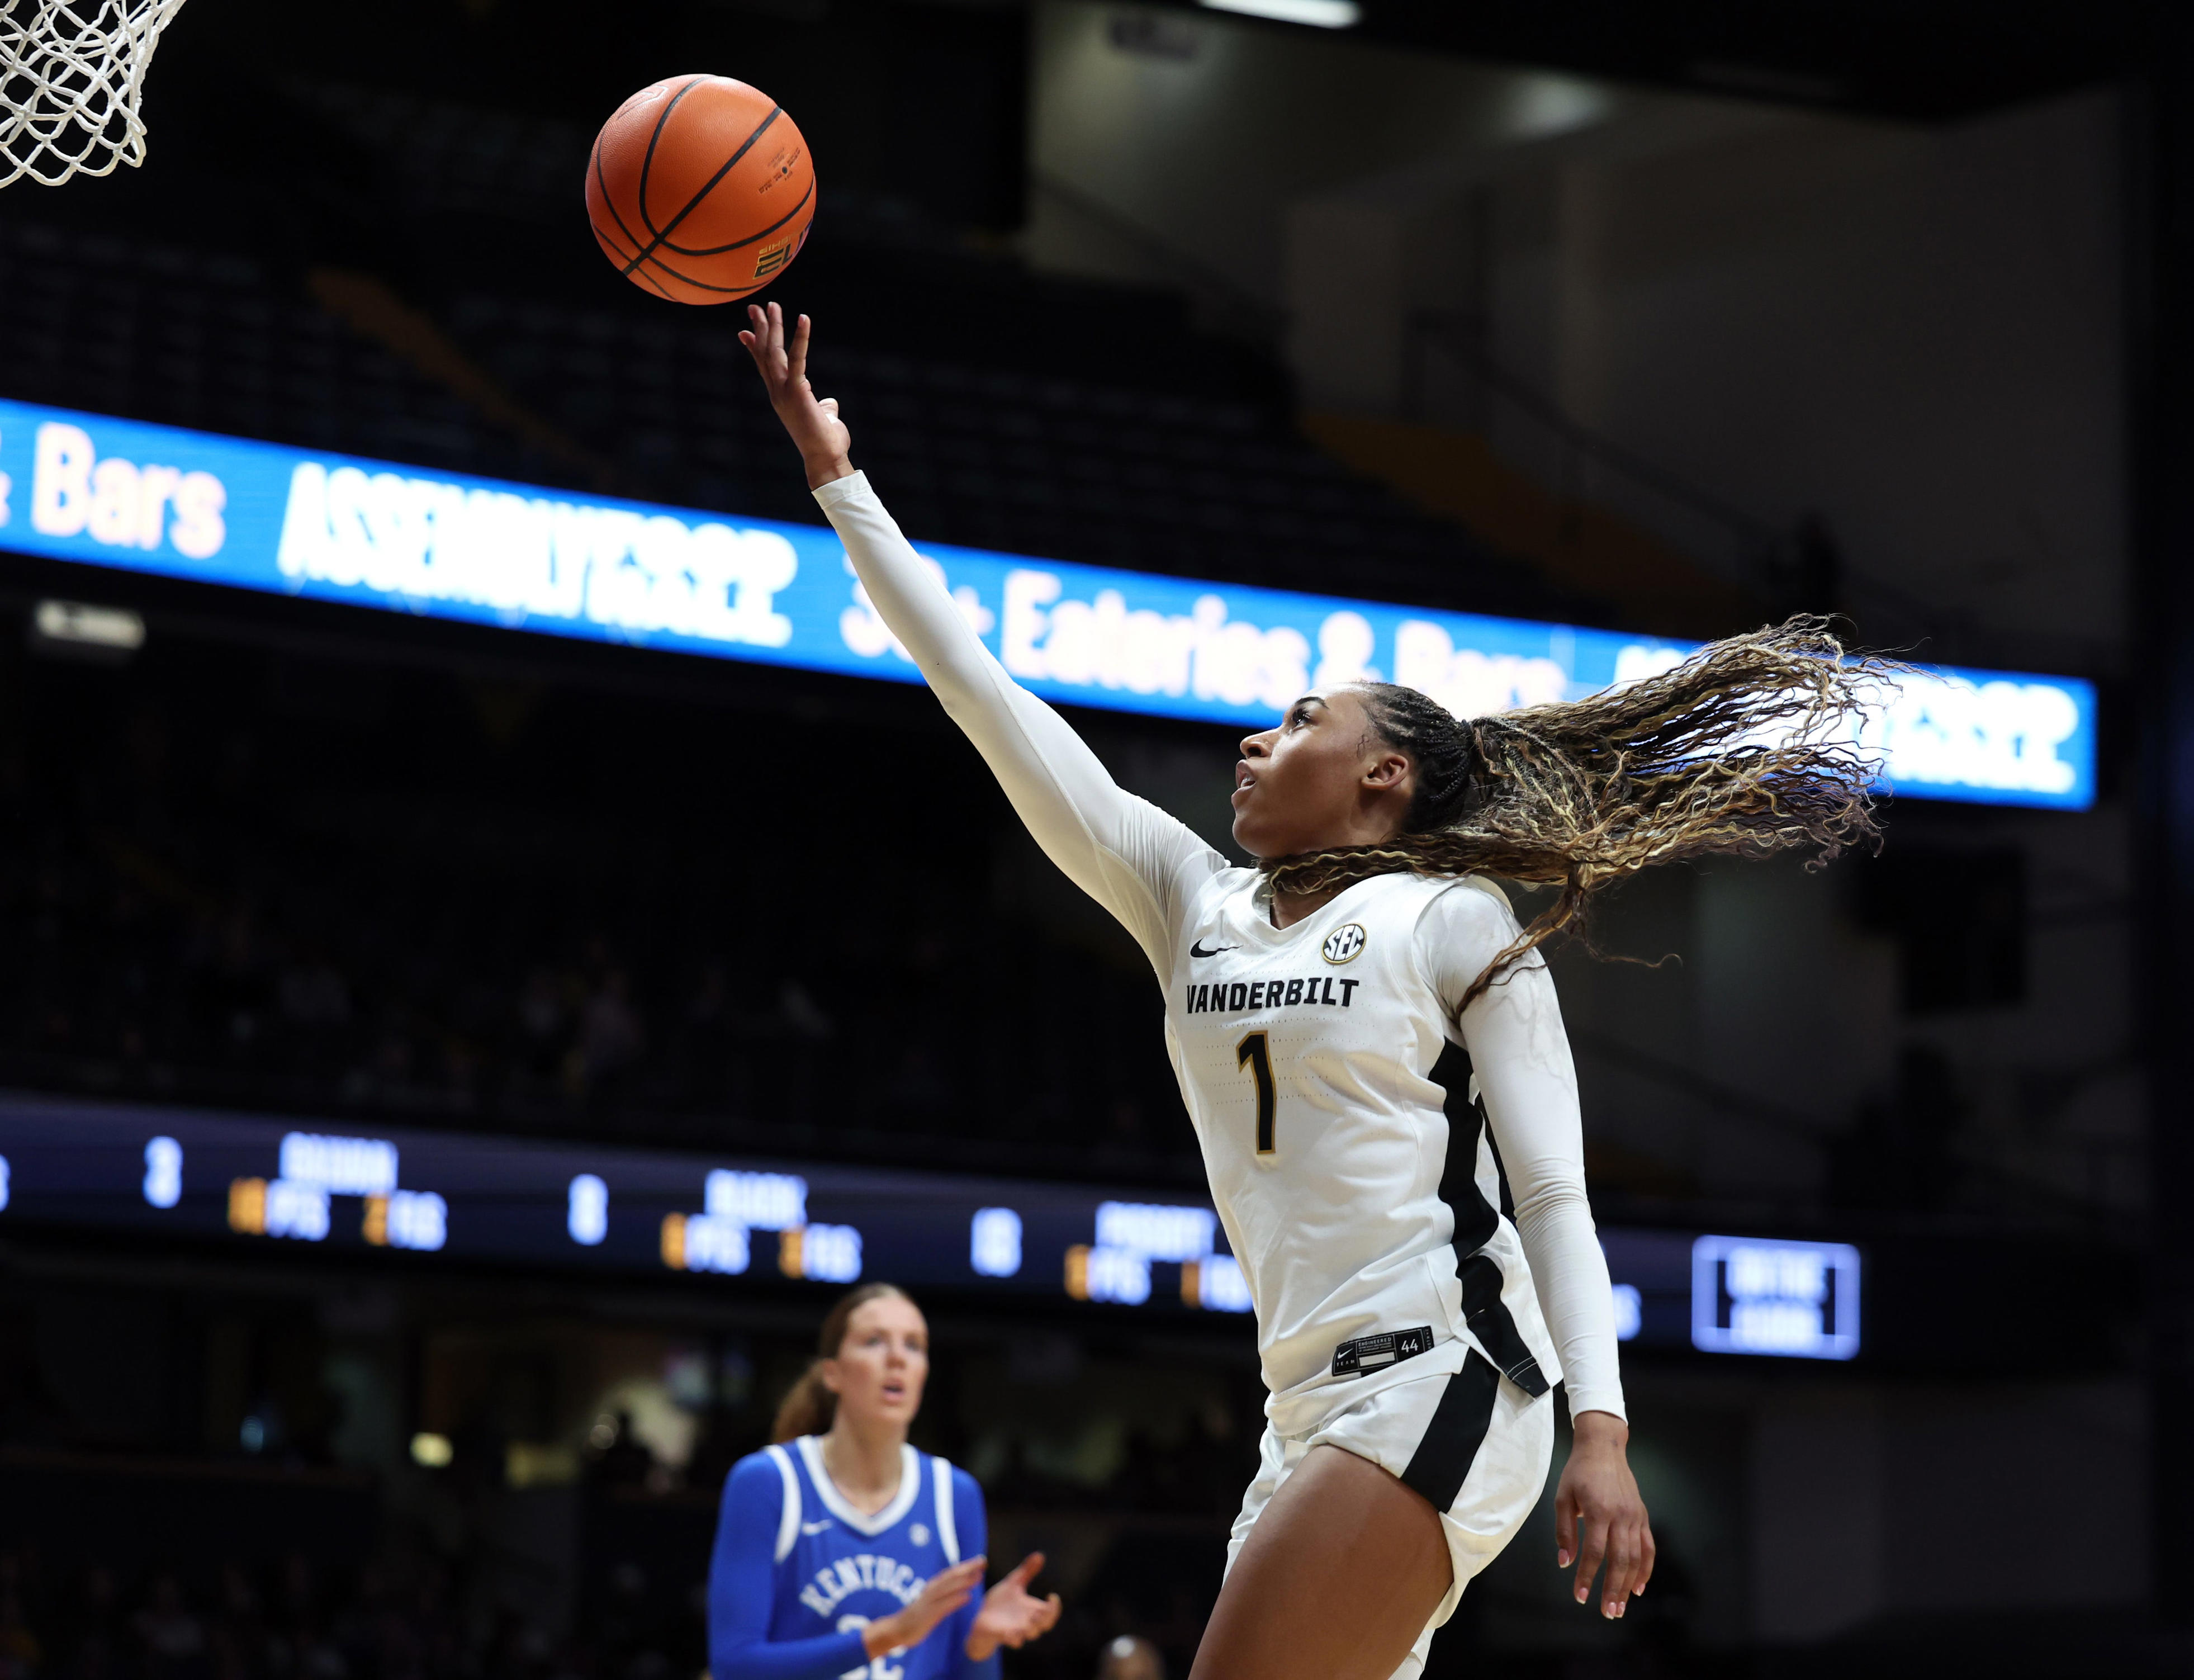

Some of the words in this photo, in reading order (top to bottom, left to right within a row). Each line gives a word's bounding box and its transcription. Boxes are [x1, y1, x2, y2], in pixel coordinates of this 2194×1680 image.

[32, 421, 226, 559] Bars
[1002, 569, 1310, 709] Eateries
[1323, 924, 1365, 961] SEC
[1187, 977, 1359, 1014] VANDERBILT
[1236, 1030, 1277, 1155] 1
[1401, 1338, 1419, 1353] 44
